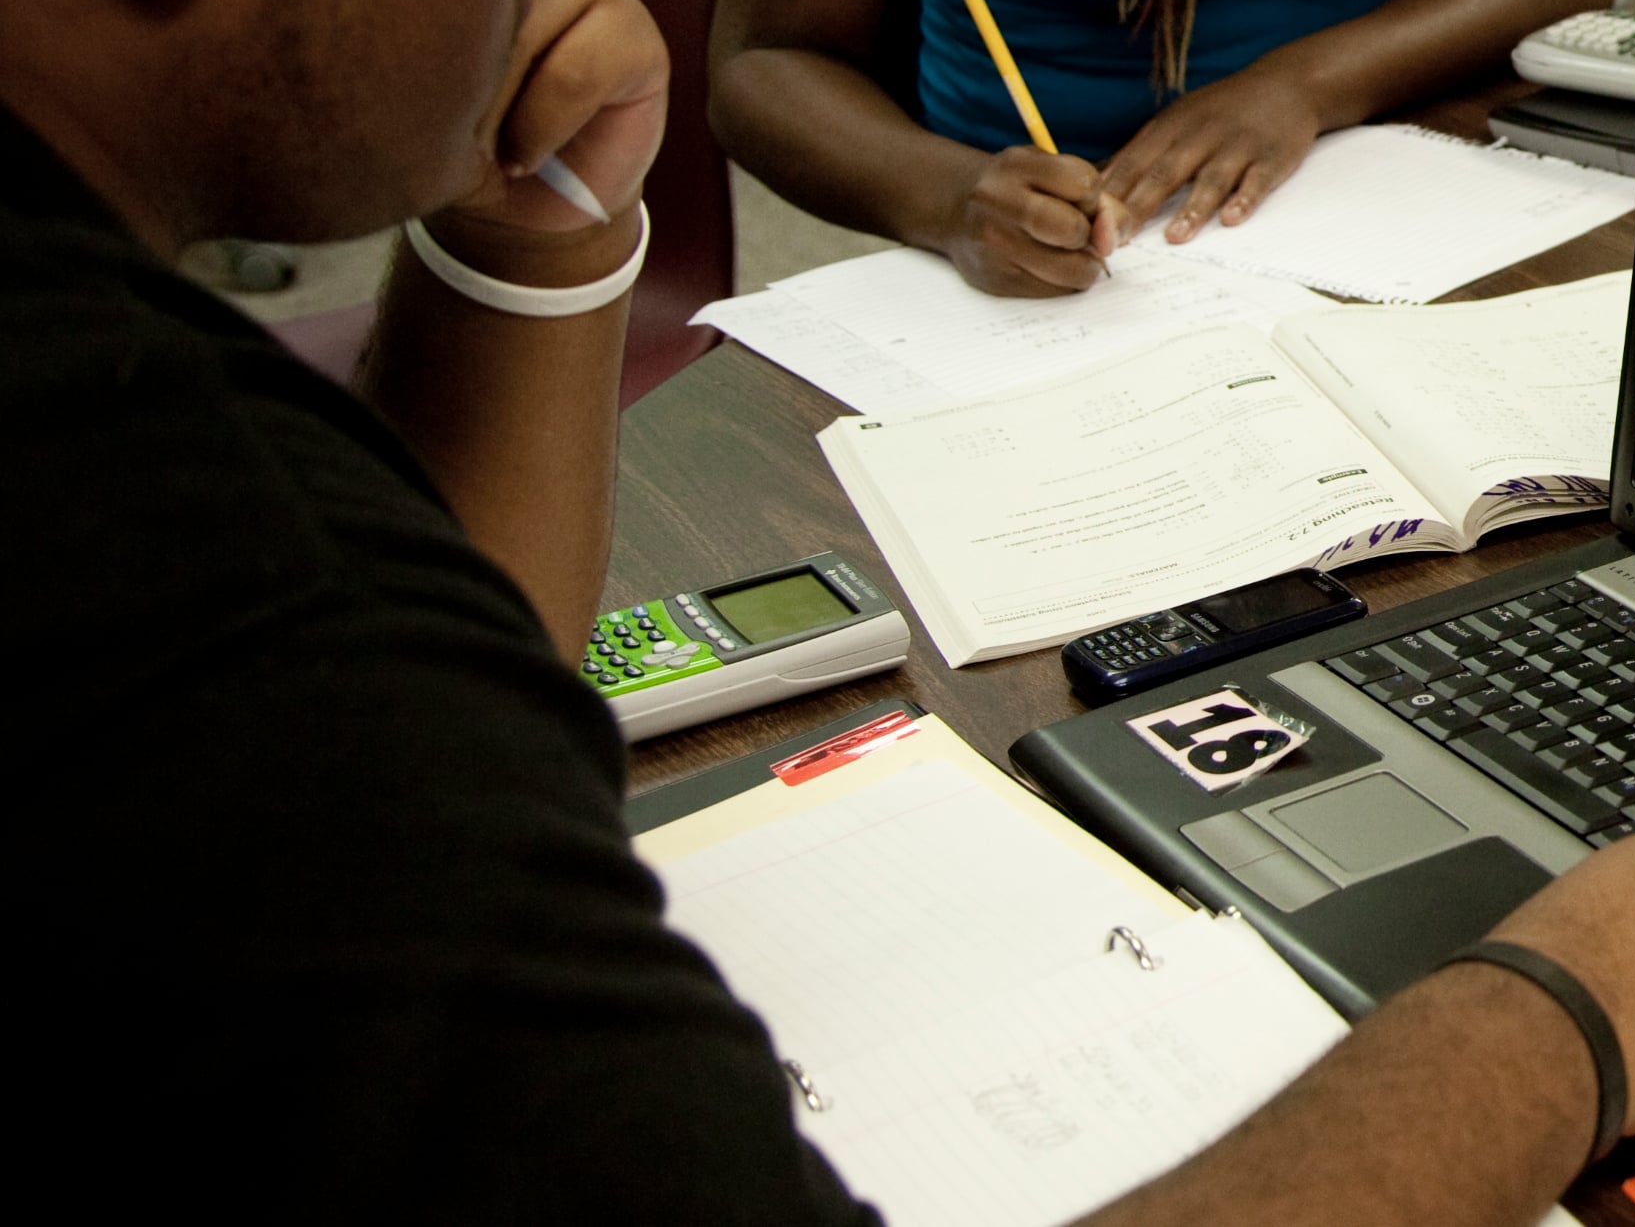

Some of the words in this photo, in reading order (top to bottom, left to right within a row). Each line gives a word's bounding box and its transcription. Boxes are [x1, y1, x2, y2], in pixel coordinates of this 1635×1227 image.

[1312, 497, 1394, 527] Reteaching
[1190, 613, 1221, 633] SAMSUNG
[1147, 703, 1291, 775] 18
